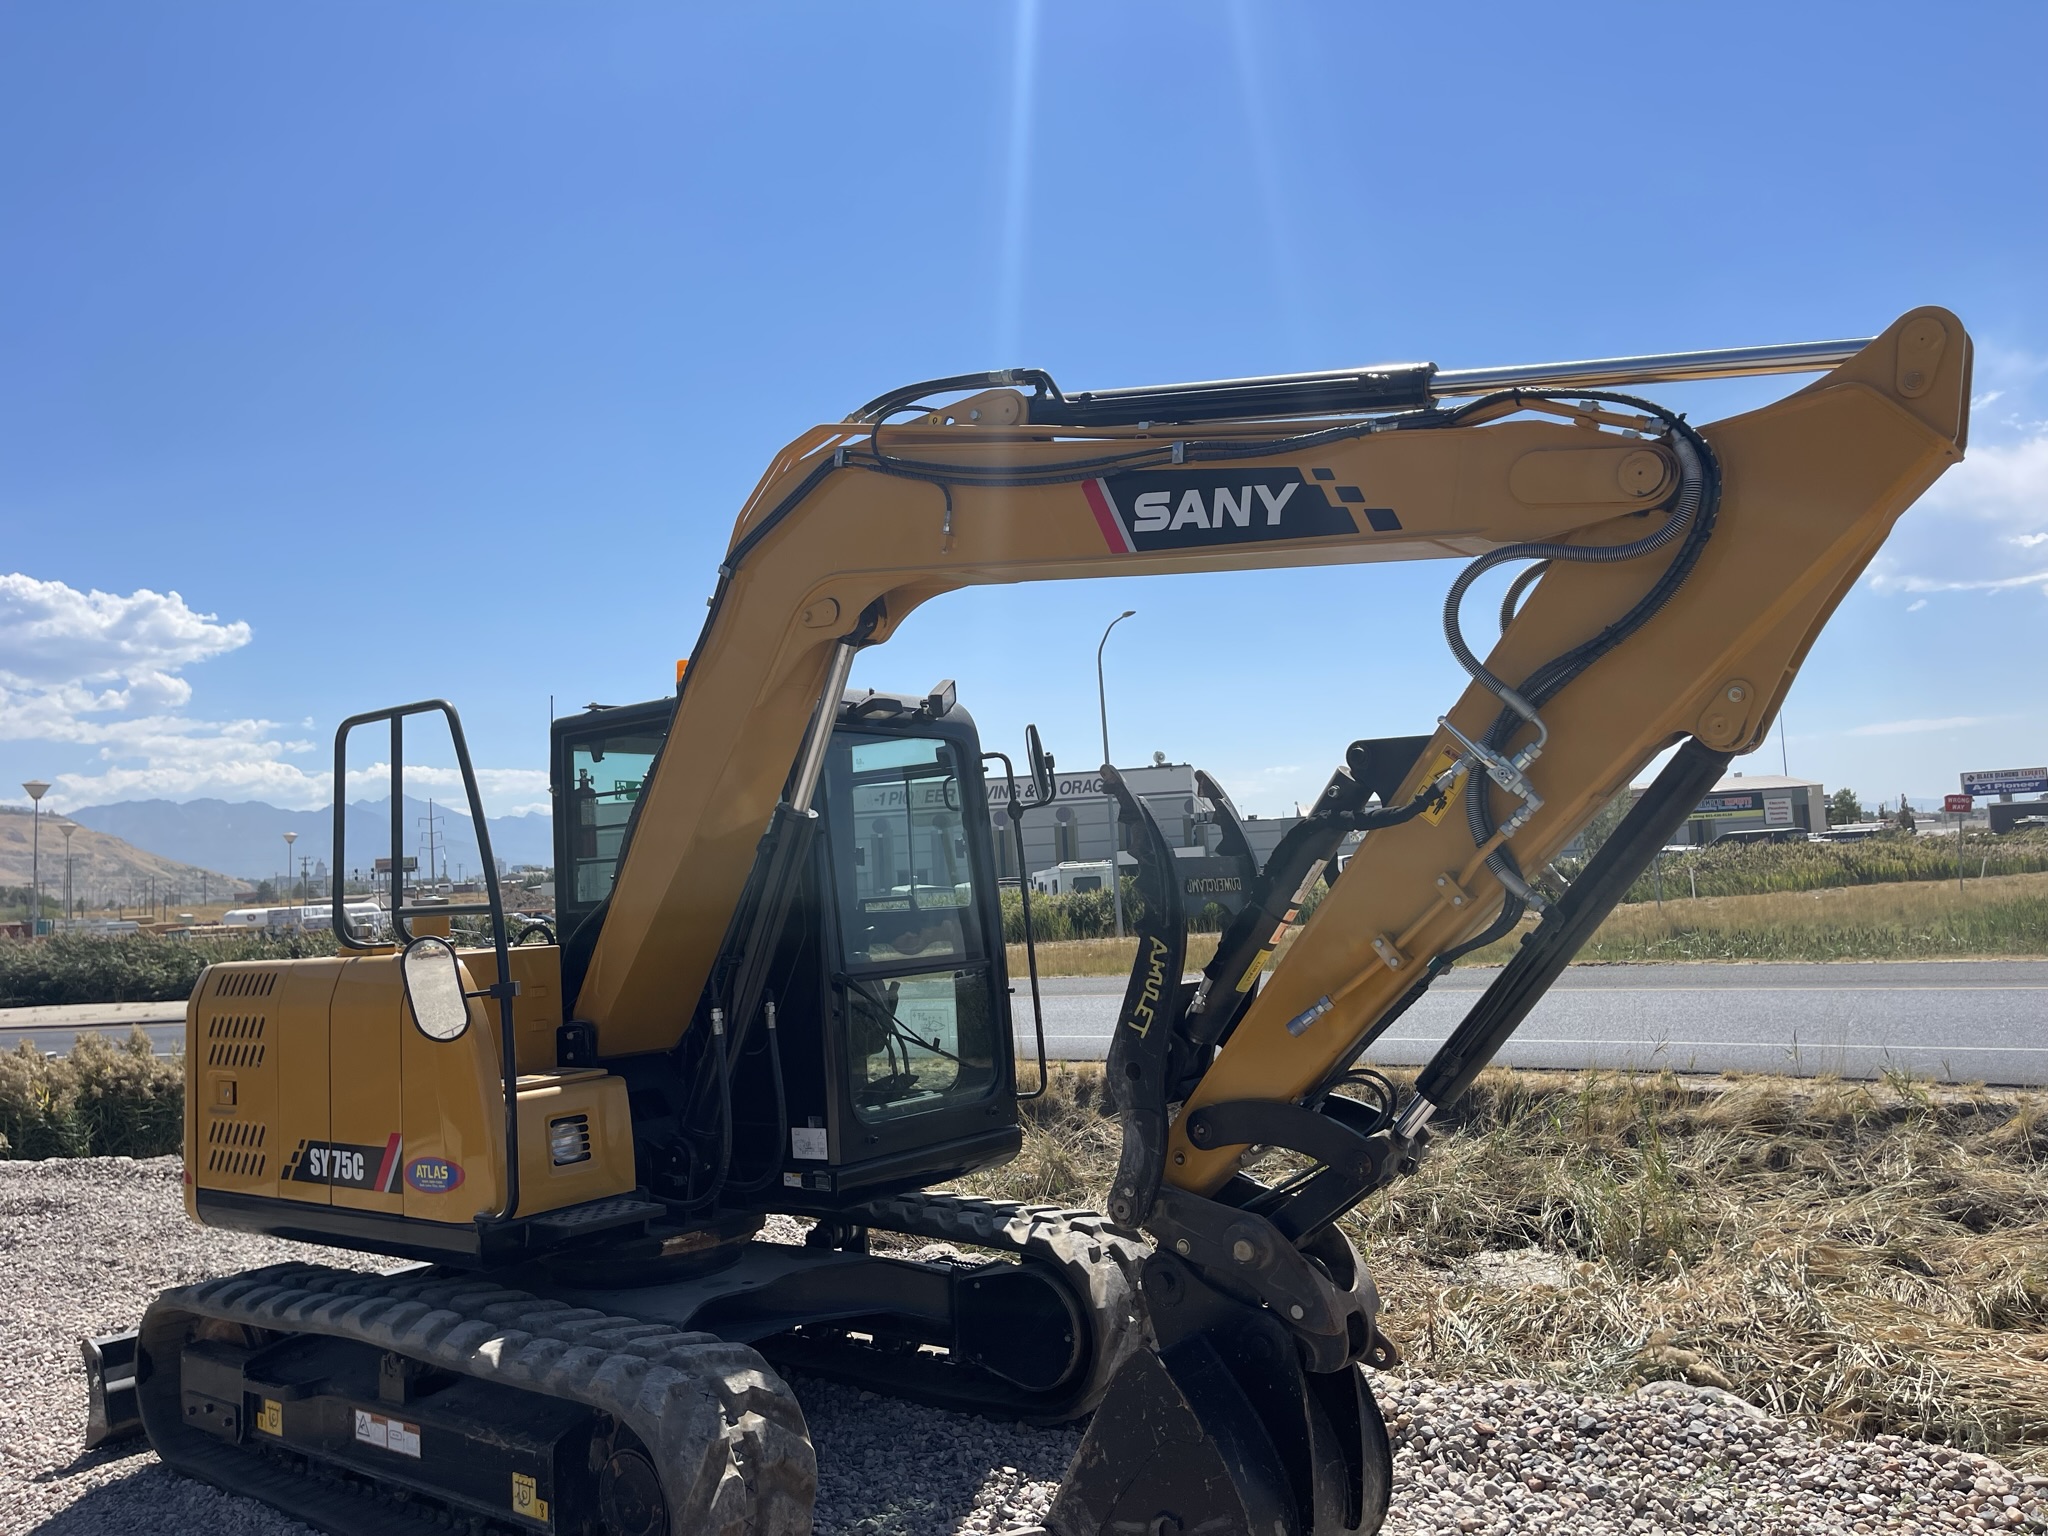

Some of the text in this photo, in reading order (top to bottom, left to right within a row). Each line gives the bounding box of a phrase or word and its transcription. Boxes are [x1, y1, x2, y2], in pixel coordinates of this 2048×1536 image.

[1133, 482, 1300, 533] SANY
[1025, 783, 1036, 798] &
[1994, 781, 2040, 789] Pioneer
[1186, 877, 1242, 893] POWERCLAMP
[1128, 936, 1168, 1039] AMULET
[416, 1164, 449, 1180] ATLAS
